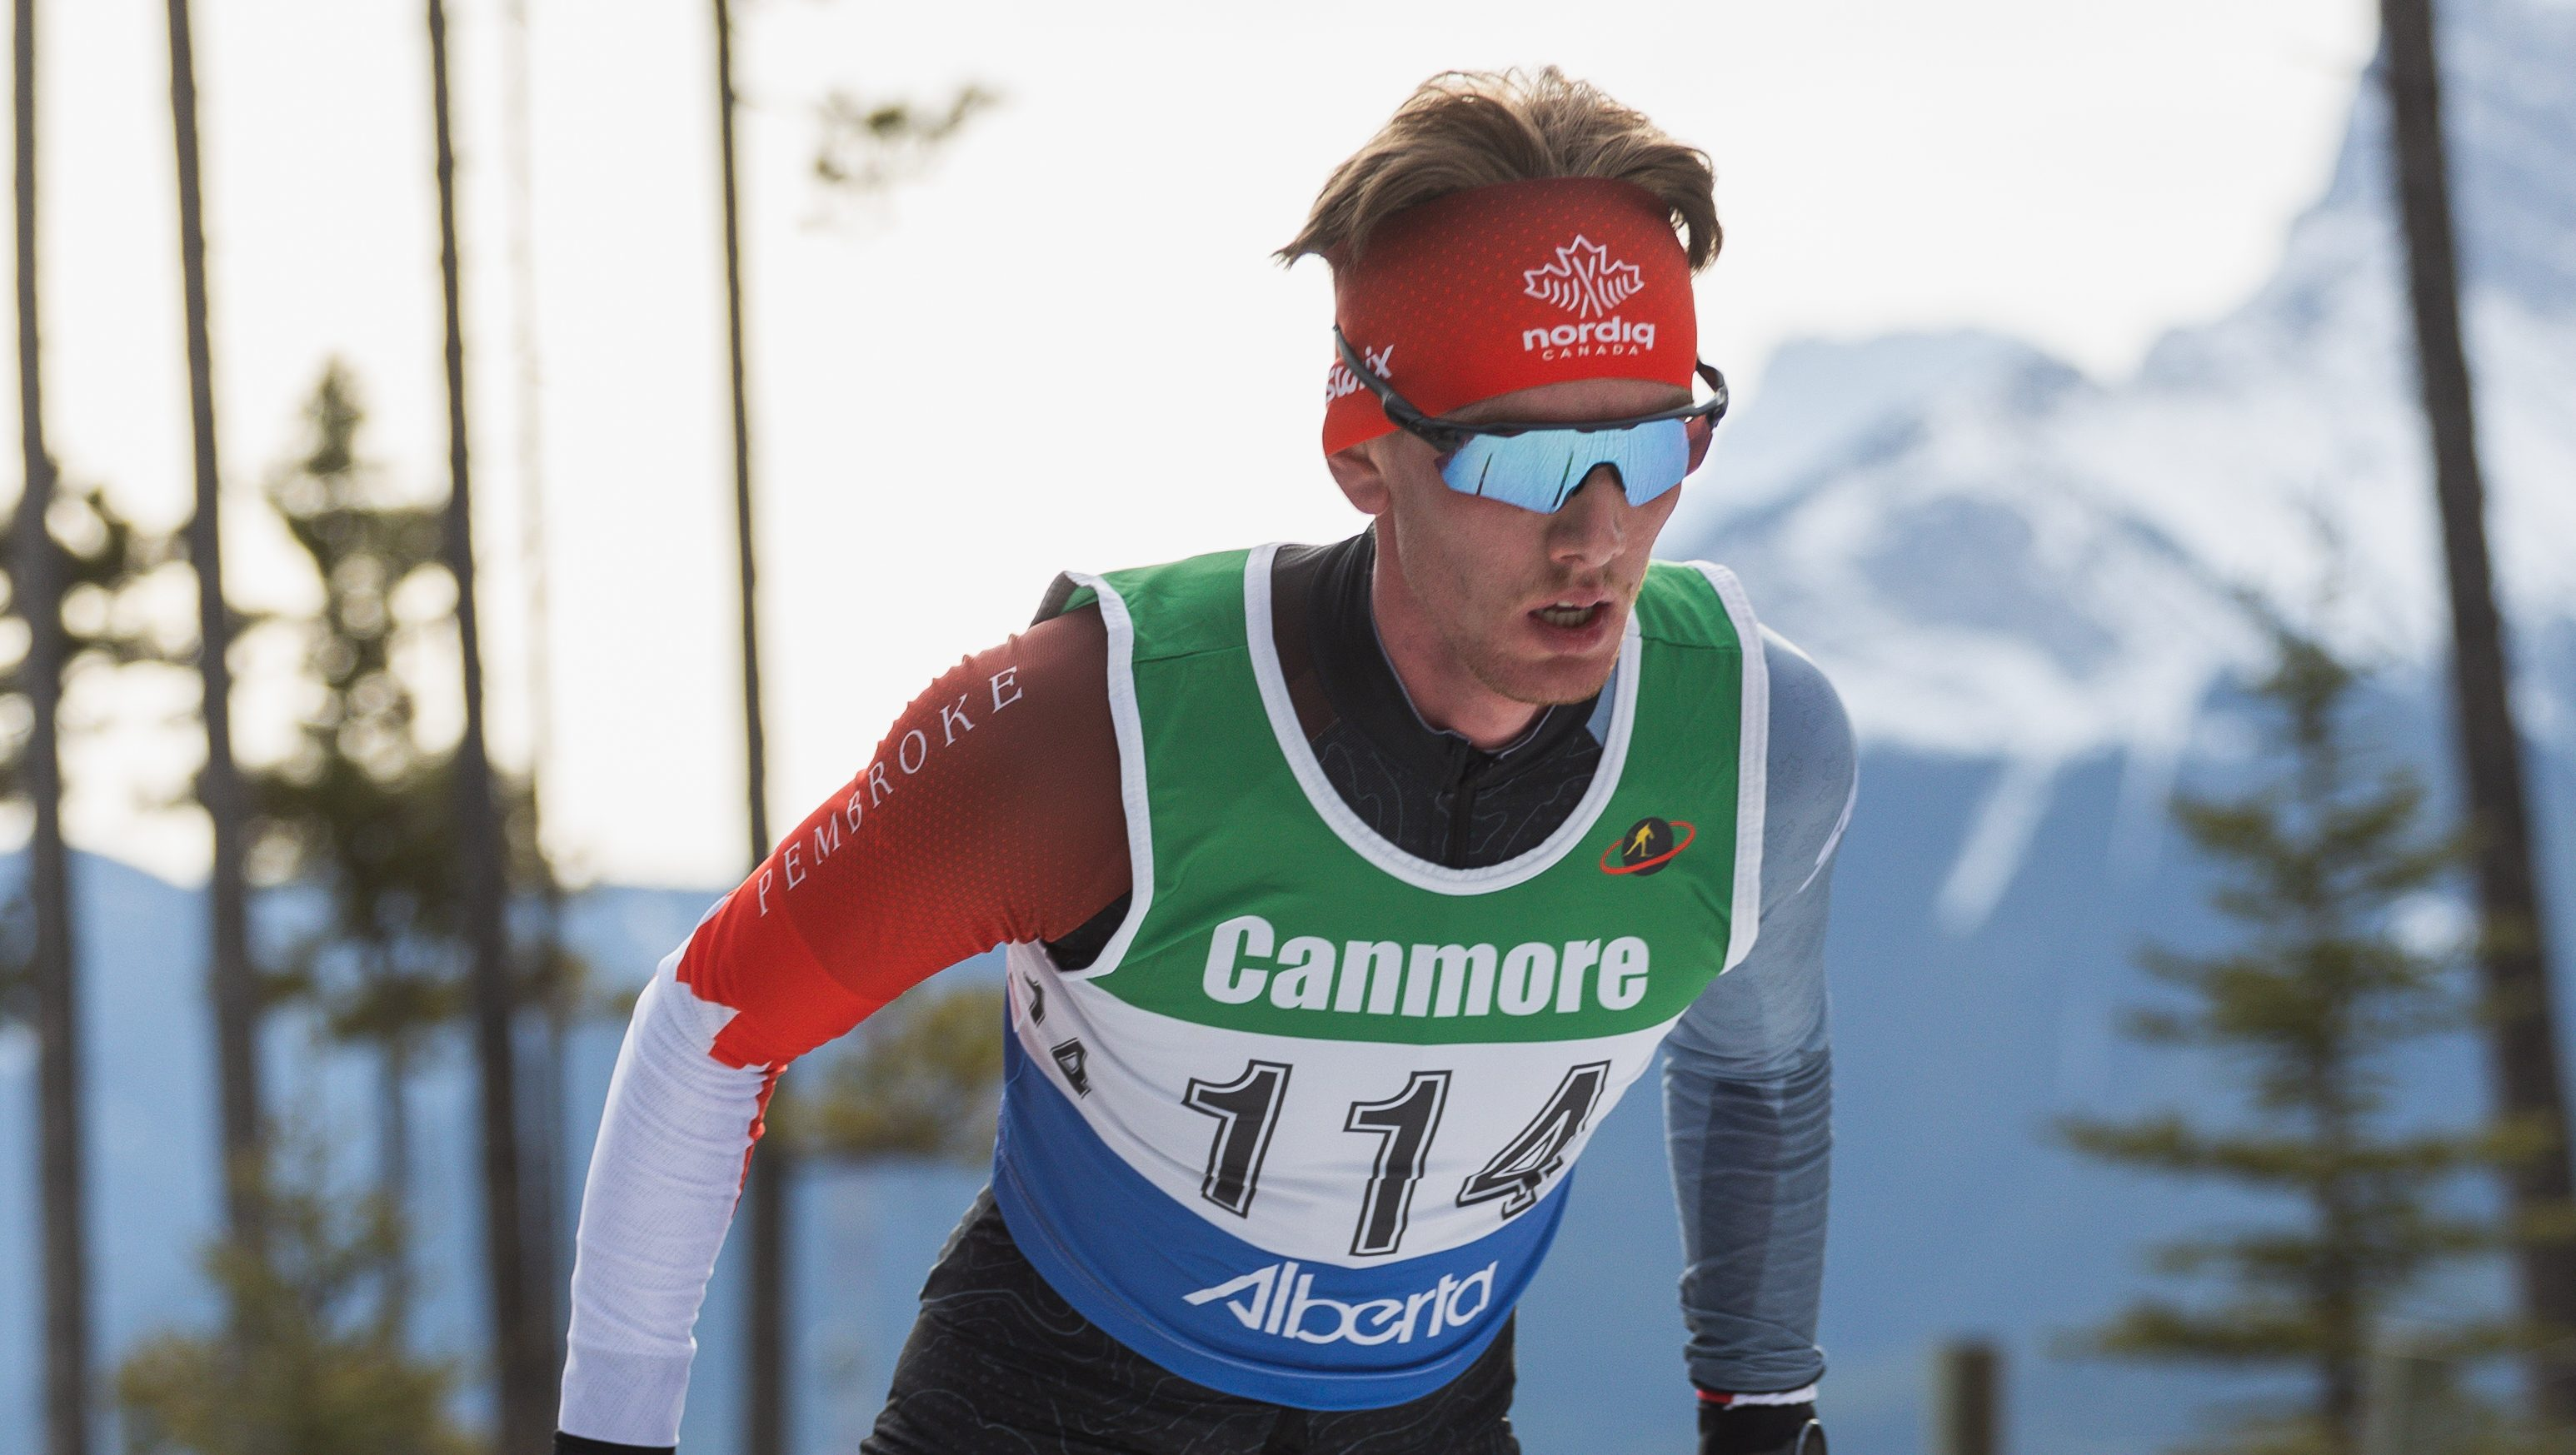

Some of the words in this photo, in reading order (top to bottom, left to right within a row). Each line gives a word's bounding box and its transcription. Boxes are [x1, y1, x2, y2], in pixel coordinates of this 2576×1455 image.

[1522, 315, 1655, 351] nordiq
[1541, 344, 1640, 361] CANADA
[757, 665, 1023, 918] PEMBROKE
[1203, 914, 1650, 1019] Canmore
[1181, 1059, 1611, 1258] 114
[1181, 1260, 1500, 1346] Alberta
